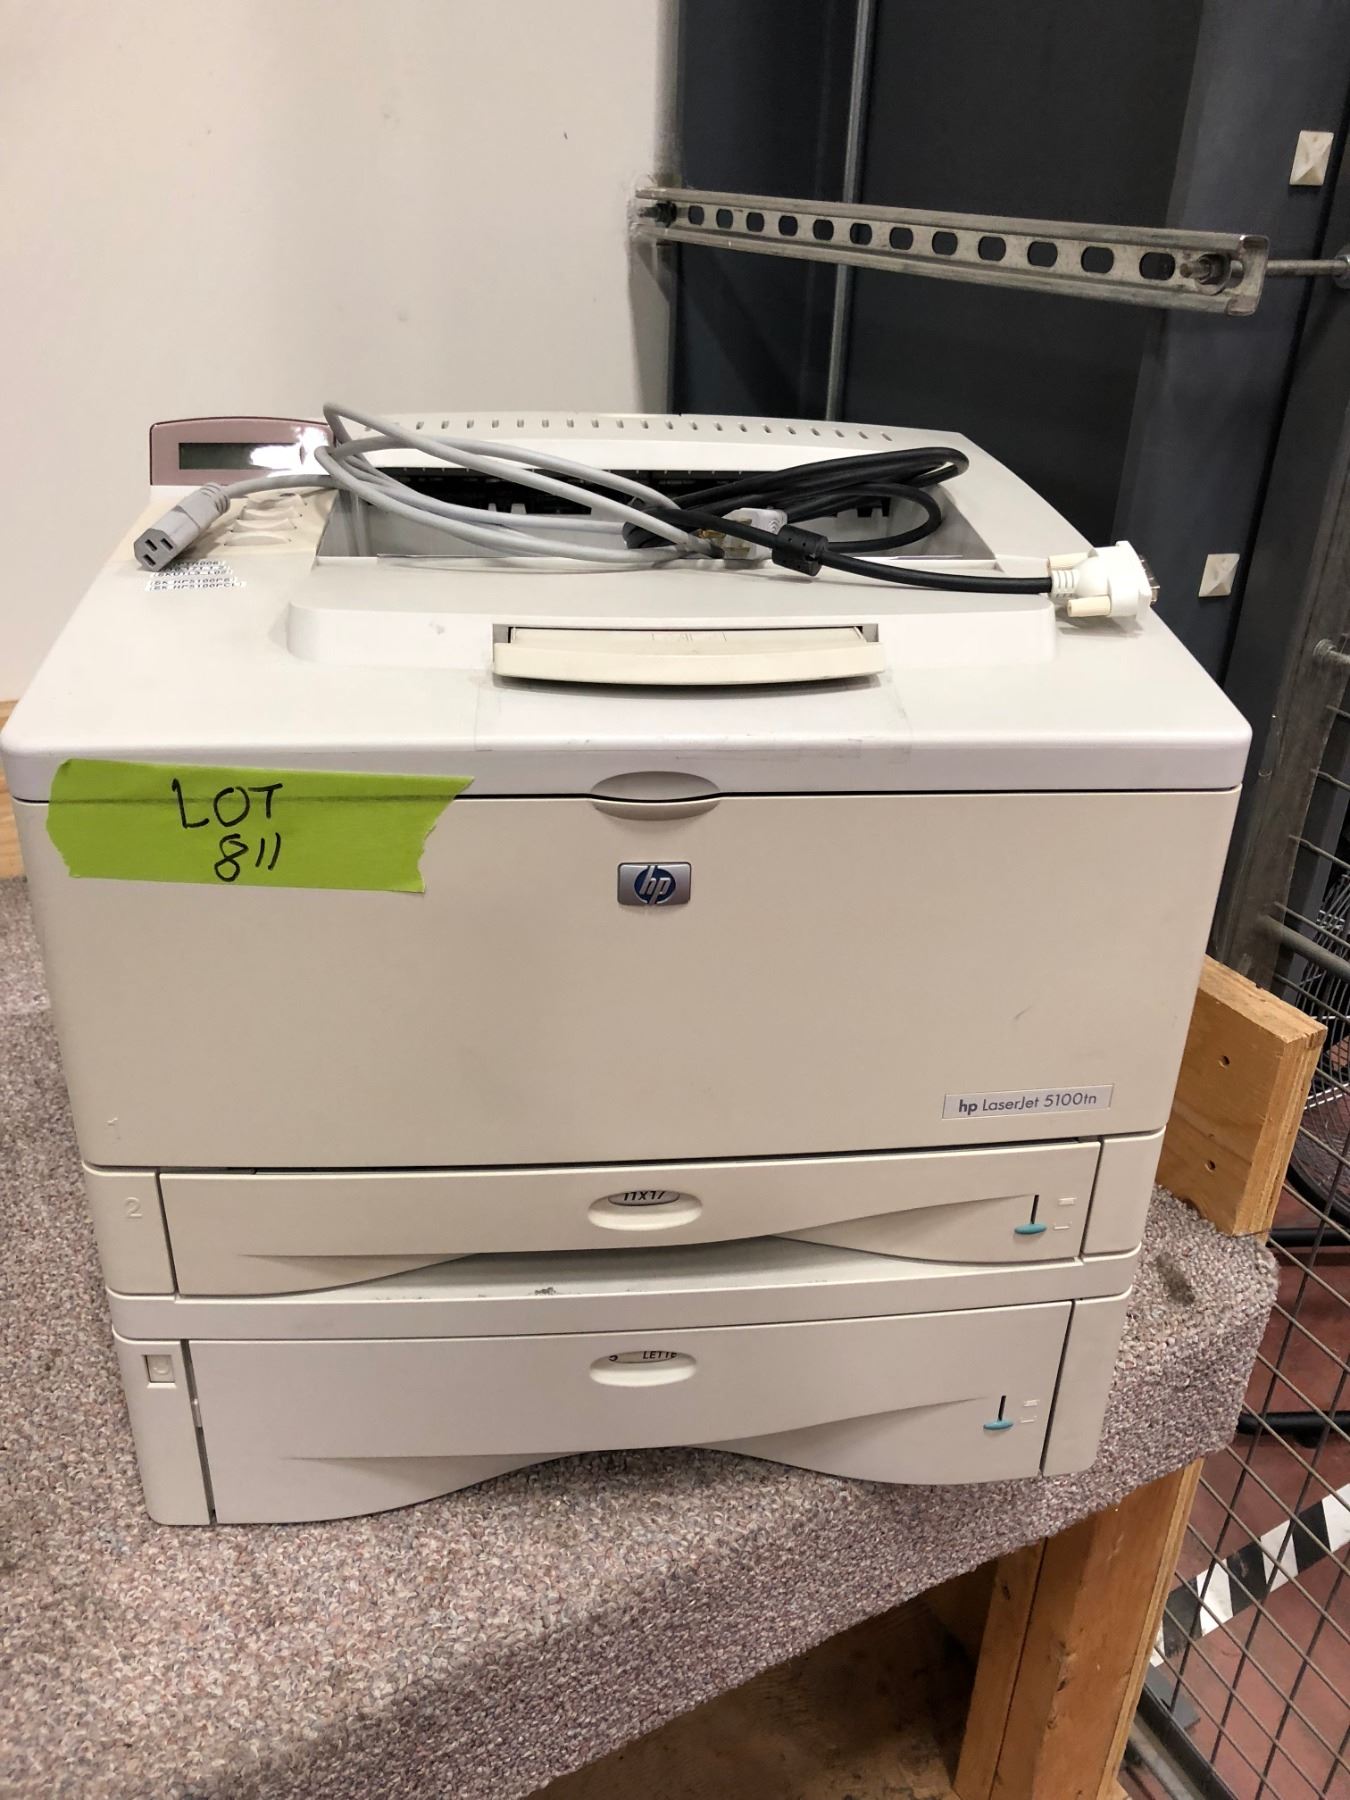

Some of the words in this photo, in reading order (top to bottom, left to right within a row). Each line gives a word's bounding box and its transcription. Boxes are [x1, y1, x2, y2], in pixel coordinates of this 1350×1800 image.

[172, 778, 283, 829] LOT
[214, 832, 281, 883] 811
[637, 864, 673, 904] hp
[958, 1098, 978, 1115] hp
[982, 1096, 1039, 1111] LaserJet
[1043, 1092, 1097, 1107] 5100tn
[124, 1196, 143, 1218] 2
